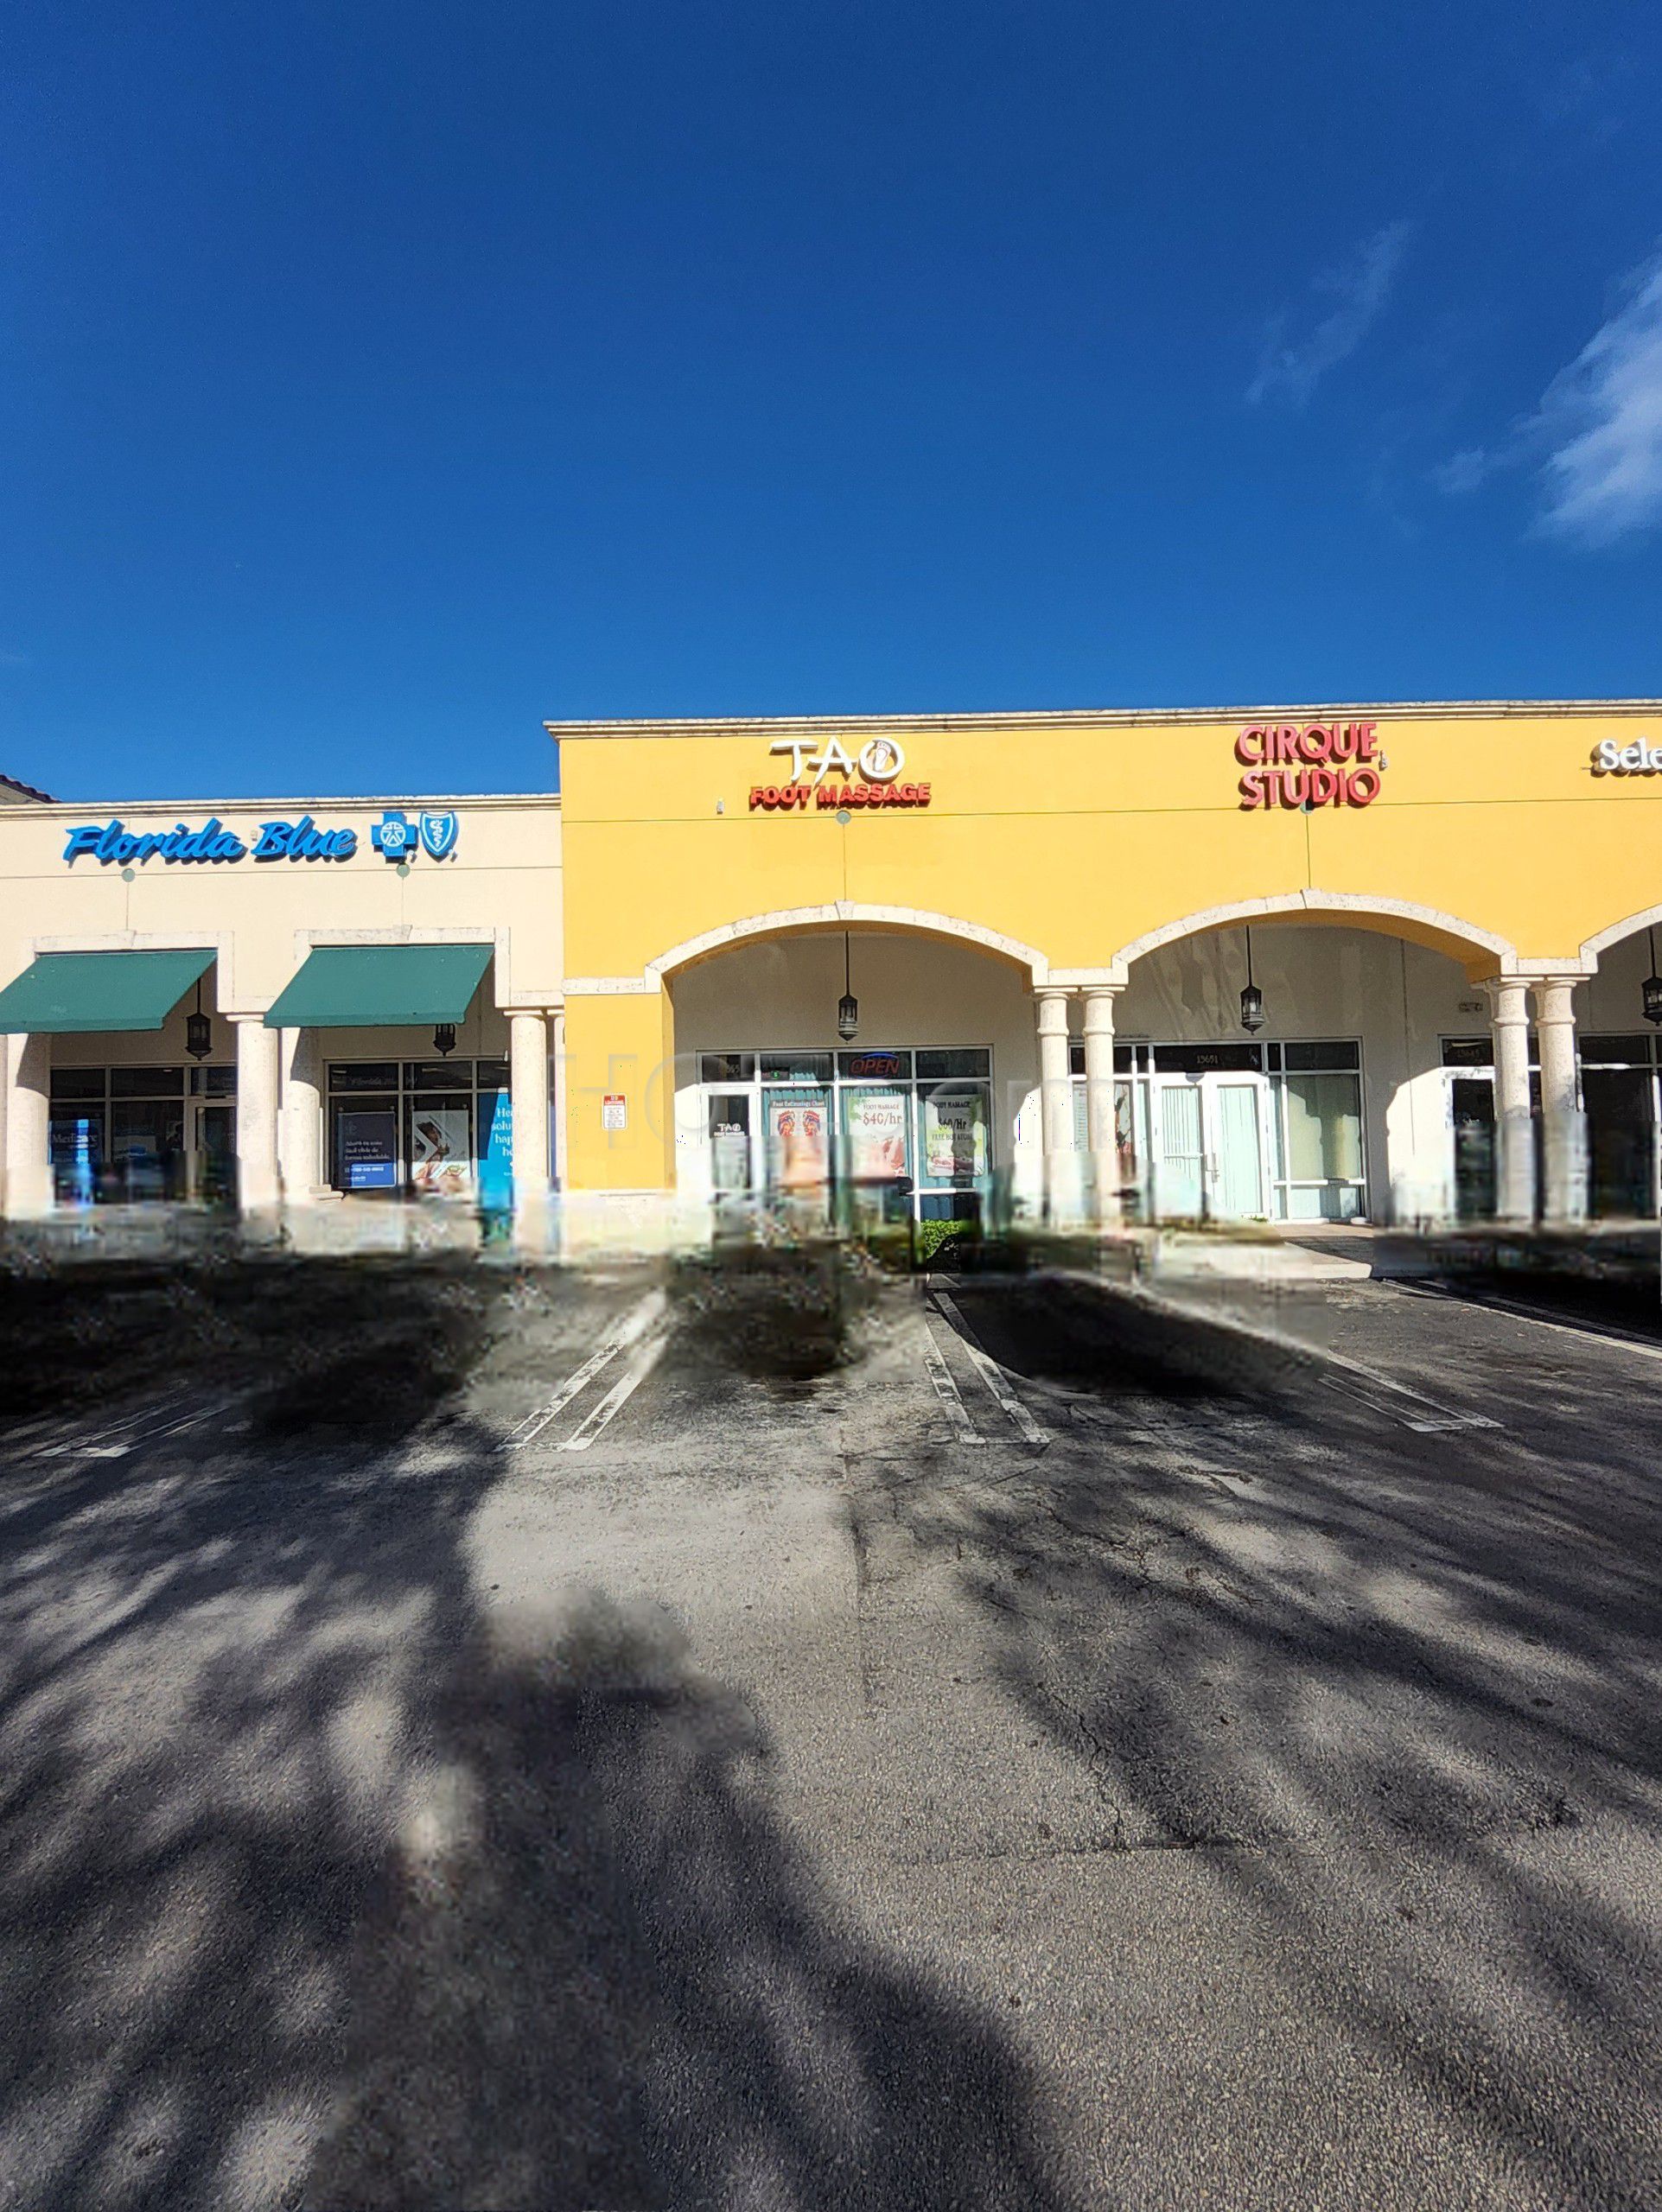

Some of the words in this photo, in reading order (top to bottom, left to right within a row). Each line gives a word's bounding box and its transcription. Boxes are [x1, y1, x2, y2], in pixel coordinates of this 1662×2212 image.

[768, 735, 907, 790] TAO
[1236, 722, 1379, 765] CIRQUE
[749, 785, 812, 809] FOOT
[817, 782, 933, 808] MASSAGE
[1239, 767, 1381, 809] STUDIO
[63, 817, 245, 865] Florida
[251, 815, 358, 862] Blue
[850, 1058, 900, 1075] OPEN
[716, 1122, 742, 1132] TAO
